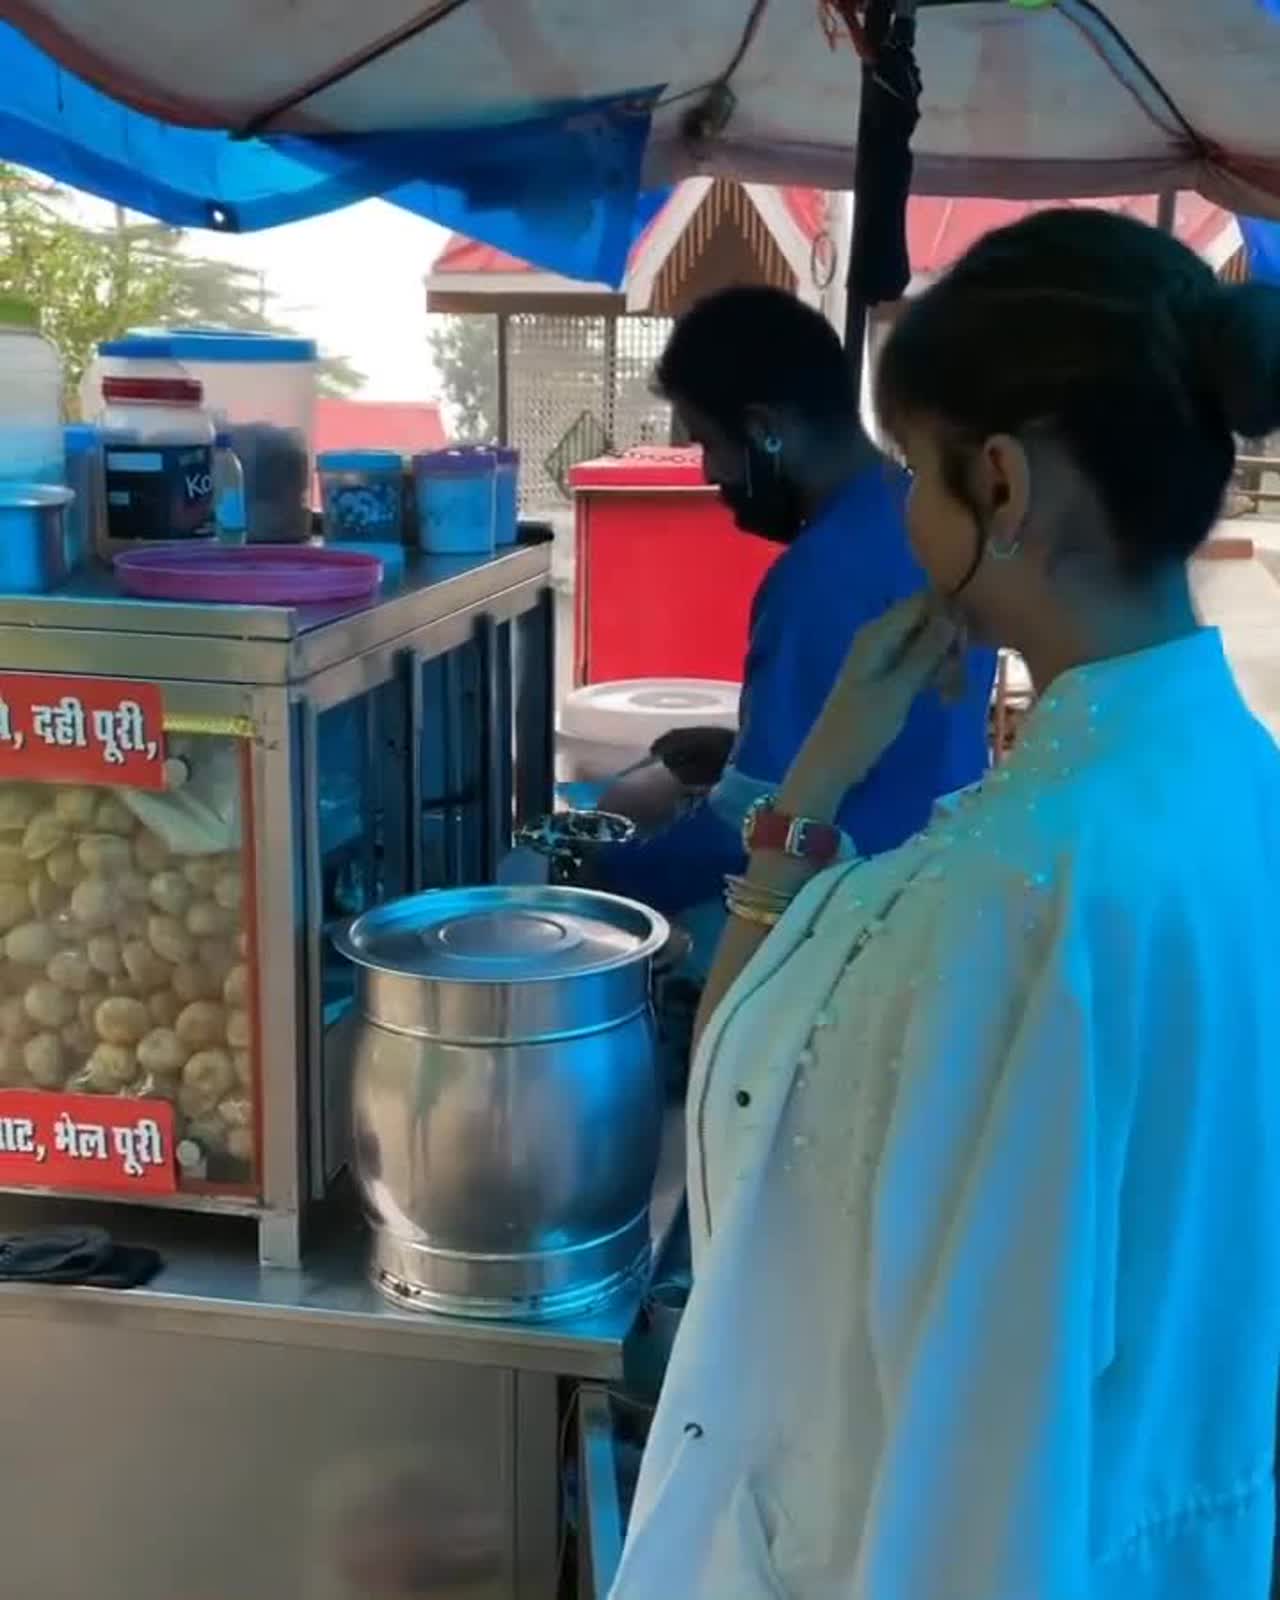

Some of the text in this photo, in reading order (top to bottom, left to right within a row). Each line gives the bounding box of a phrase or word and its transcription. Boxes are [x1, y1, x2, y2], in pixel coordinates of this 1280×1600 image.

[31, 696, 87, 746] दही
[92, 700, 157, 764] पूरी,
[0, 1112, 163, 1177] ाट, भेल पूरी
